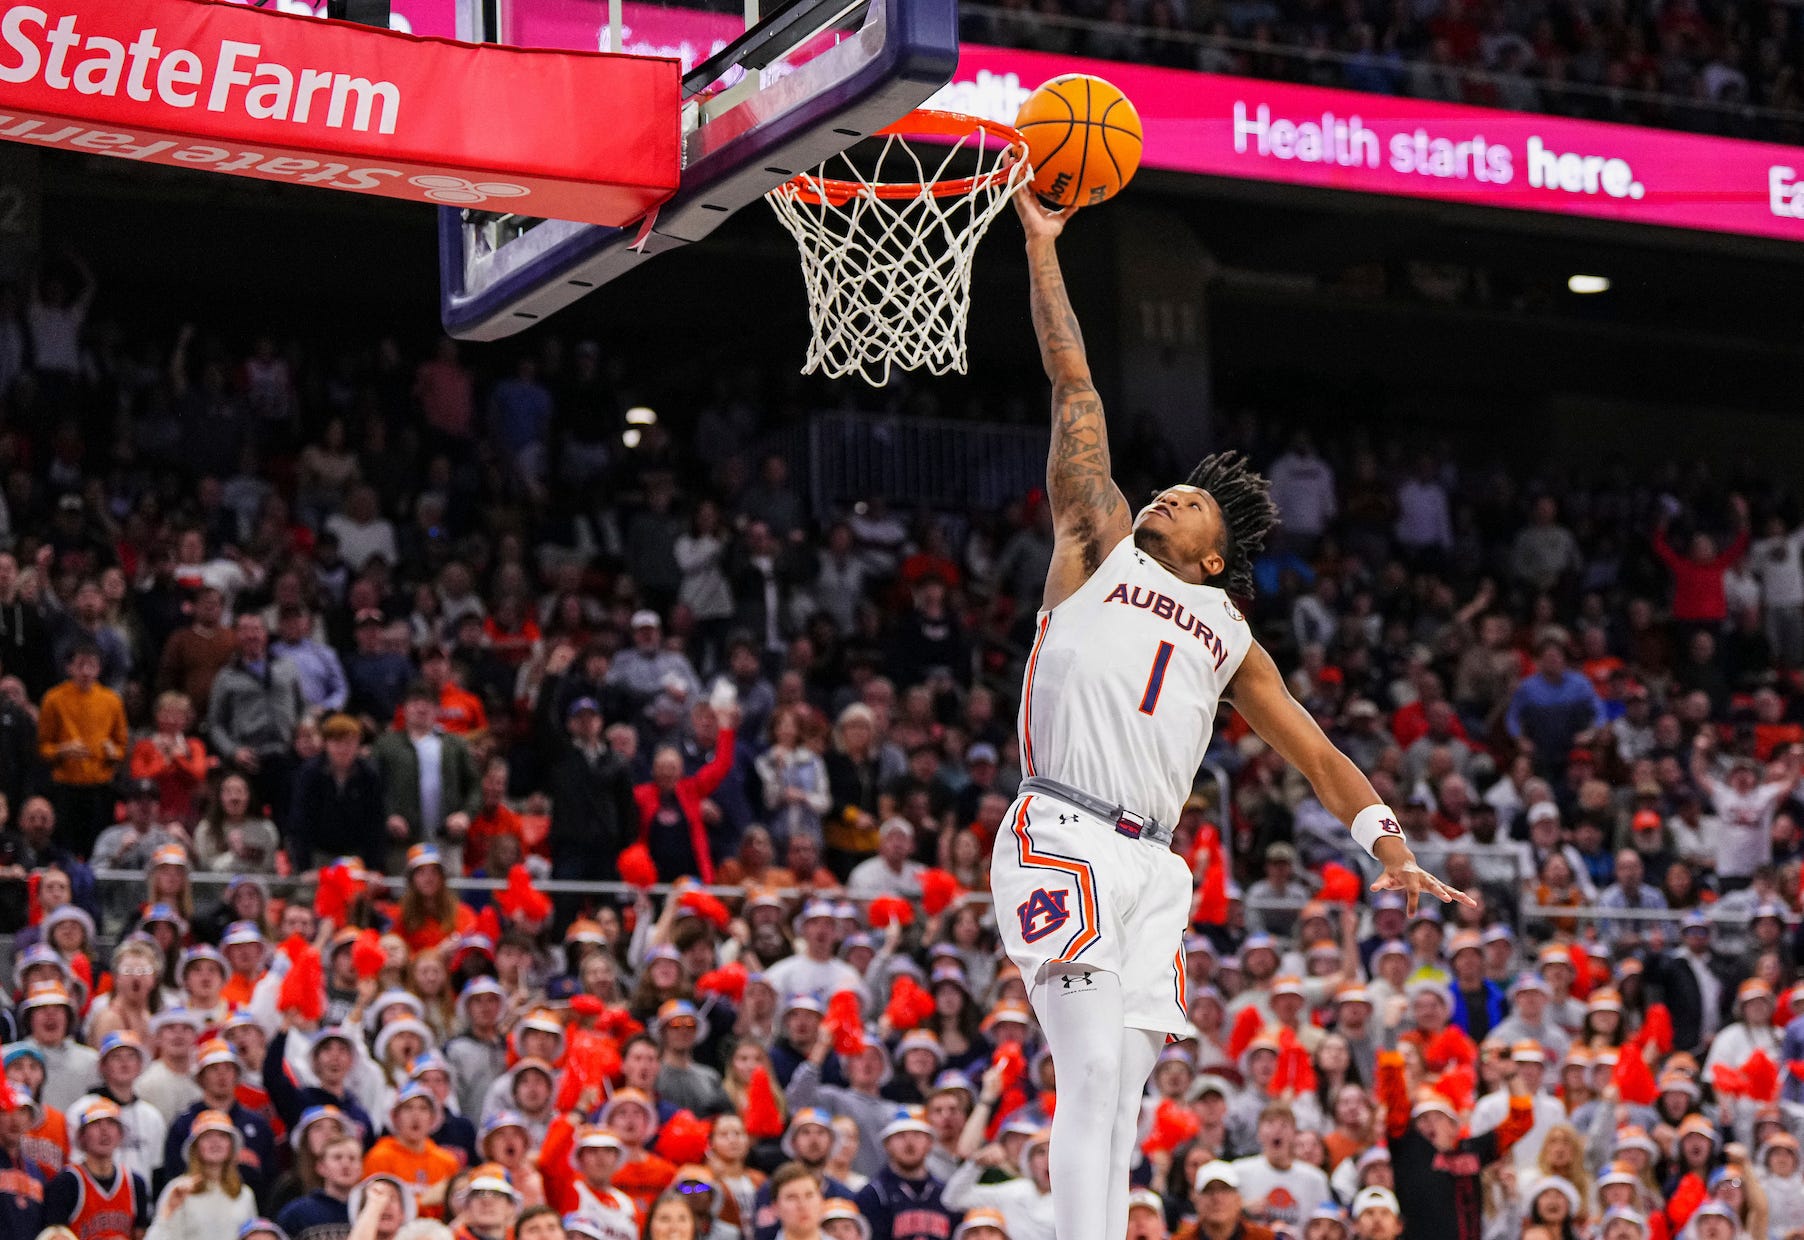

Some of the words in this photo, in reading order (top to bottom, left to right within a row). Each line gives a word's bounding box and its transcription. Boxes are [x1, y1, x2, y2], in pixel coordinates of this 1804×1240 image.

[1233, 100, 1380, 169] Health
[1389, 127, 1514, 184] starts
[1527, 135, 1645, 200] here.
[1103, 583, 1229, 673] AUBURN
[1138, 640, 1175, 716] 1
